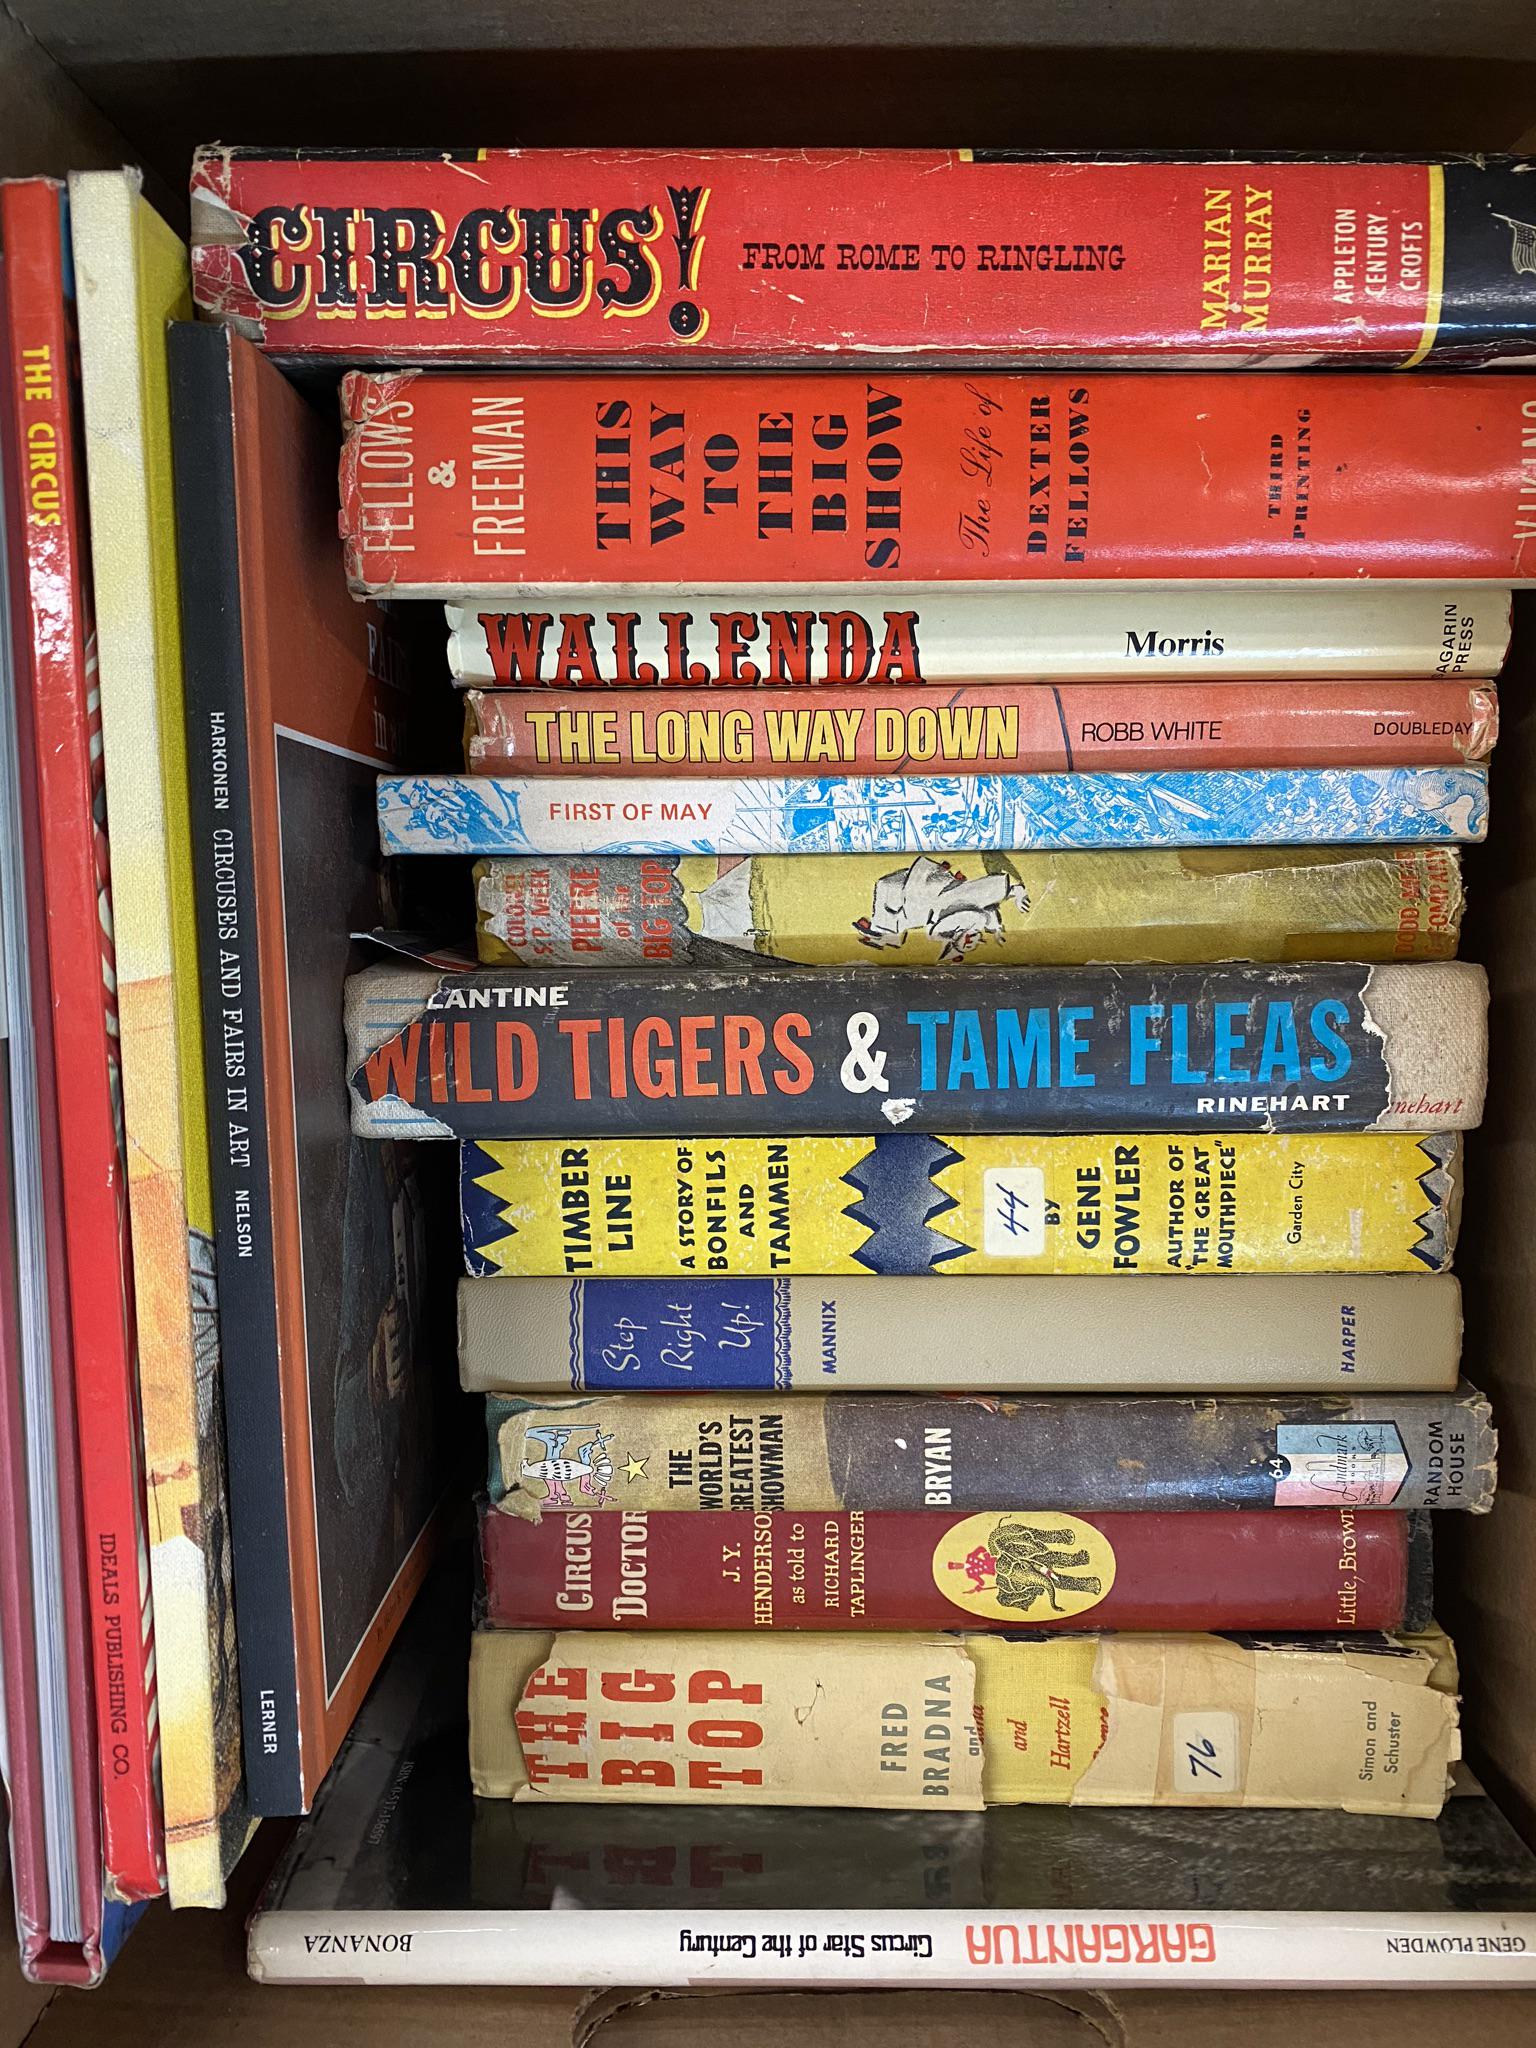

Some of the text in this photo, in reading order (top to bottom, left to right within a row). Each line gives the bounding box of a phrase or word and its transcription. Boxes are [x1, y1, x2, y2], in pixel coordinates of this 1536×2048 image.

[237, 185, 711, 344] CIRCUS!
[743, 243, 1127, 272] FROM ROME TO RINGLING
[1201, 187, 1232, 331] MARIAN
[1240, 184, 1274, 334] MURRAY
[1333, 208, 1356, 304] APPLETON
[1366, 211, 1388, 298] CENTURY
[1400, 220, 1424, 292] CROFTS
[22, 346, 62, 527] THE CIRCUS
[361, 397, 415, 552] FELLOWS
[428, 459, 456, 488] &
[471, 396, 526, 555] FREEMAN
[595, 399, 633, 550] THIS
[650, 402, 685, 547] WAY
[704, 433, 740, 514] TO
[758, 411, 794, 539] THE
[811, 413, 848, 535] BIG
[864, 384, 903, 569] SHOW
[959, 383, 1003, 557] The Life of
[1027, 395, 1050, 554] DEXTER
[1064, 388, 1089, 562] FELLOWS
[1268, 434, 1283, 518] THIRD
[1293, 409, 1310, 540] PRINTING
[477, 611, 926, 687] WALLENDA
[1125, 629, 1225, 658] Morris
[1452, 617, 1474, 672] PRESS
[525, 705, 1019, 763] THE LONG WAY DOWN
[1081, 720, 1222, 742] ROBB WHITE
[1373, 721, 1473, 736] DOUBLEDAY
[549, 803, 713, 822] FIRST OF MAY
[611, 921, 631, 939] of
[641, 859, 673, 958] BIG TOP
[209, 711, 254, 1258] HARKONEN CIRCUSES AND FAIRS IN ART NELSON
[364, 999, 1353, 1104] WILD TIGERS & TAME FLEAS
[1197, 1093, 1351, 1115] RINEHART
[561, 1146, 592, 1272] TIMBER
[605, 1174, 632, 1252] LINE
[677, 1146, 695, 1269] A STORY OF
[707, 1149, 726, 1270] BONFILS
[739, 1183, 754, 1238] AND
[770, 1144, 790, 1268] TAMMEN
[1044, 1199, 1060, 1225] BY
[1077, 1166, 1101, 1250] GENE
[1113, 1145, 1139, 1269] FOWLER
[1167, 1144, 1184, 1268] AUTHOR OF
[1193, 1146, 1210, 1219] GREAT
[1287, 1160, 1304, 1245] Garden City
[601, 1315, 647, 1371] Step
[660, 1301, 707, 1371] Right
[718, 1301, 763, 1348] Up!
[822, 1300, 837, 1374] MANNIX
[1341, 1305, 1356, 1373] HARPER
[669, 1449, 692, 1488] THE
[699, 1421, 723, 1510] WORLD'S
[760, 1414, 784, 1511] SHOWMAN
[925, 1427, 951, 1505] BRYAN
[1269, 1458, 1283, 1478] 64
[1308, 1434, 1358, 1501] Landmark
[1424, 1421, 1443, 1505] RANDOM
[1447, 1434, 1464, 1495] HOUSE
[787, 1523, 805, 1604] as told to
[824, 1521, 840, 1608] RICHARD
[849, 1511, 865, 1617] TAPLINGER
[1337, 1509, 1365, 1625] Little, Brown
[99, 1534, 131, 1780] IDEALS PUBLISHING CO.
[260, 1689, 276, 1755] LERNER
[515, 1668, 588, 1785] THE
[600, 1669, 676, 1787] BIG
[687, 1669, 763, 1789] TOP
[880, 1703, 908, 1772] FRED
[923, 1675, 951, 1796] BRADNA
[964, 1726, 980, 1756] and
[1007, 1718, 1028, 1751] and
[1048, 1695, 1072, 1770] Hartzell
[1191, 1735, 1221, 1778] 76
[1359, 1701, 1378, 1782] Simon and
[1383, 1711, 1402, 1774] Schuster
[304, 1935, 412, 1954] BONANZA
[680, 1929, 933, 1958] Circus Star of the Century
[965, 1923, 1217, 1965] GARGANTUA
[1386, 1936, 1526, 1954] GENE PLOWDEN
